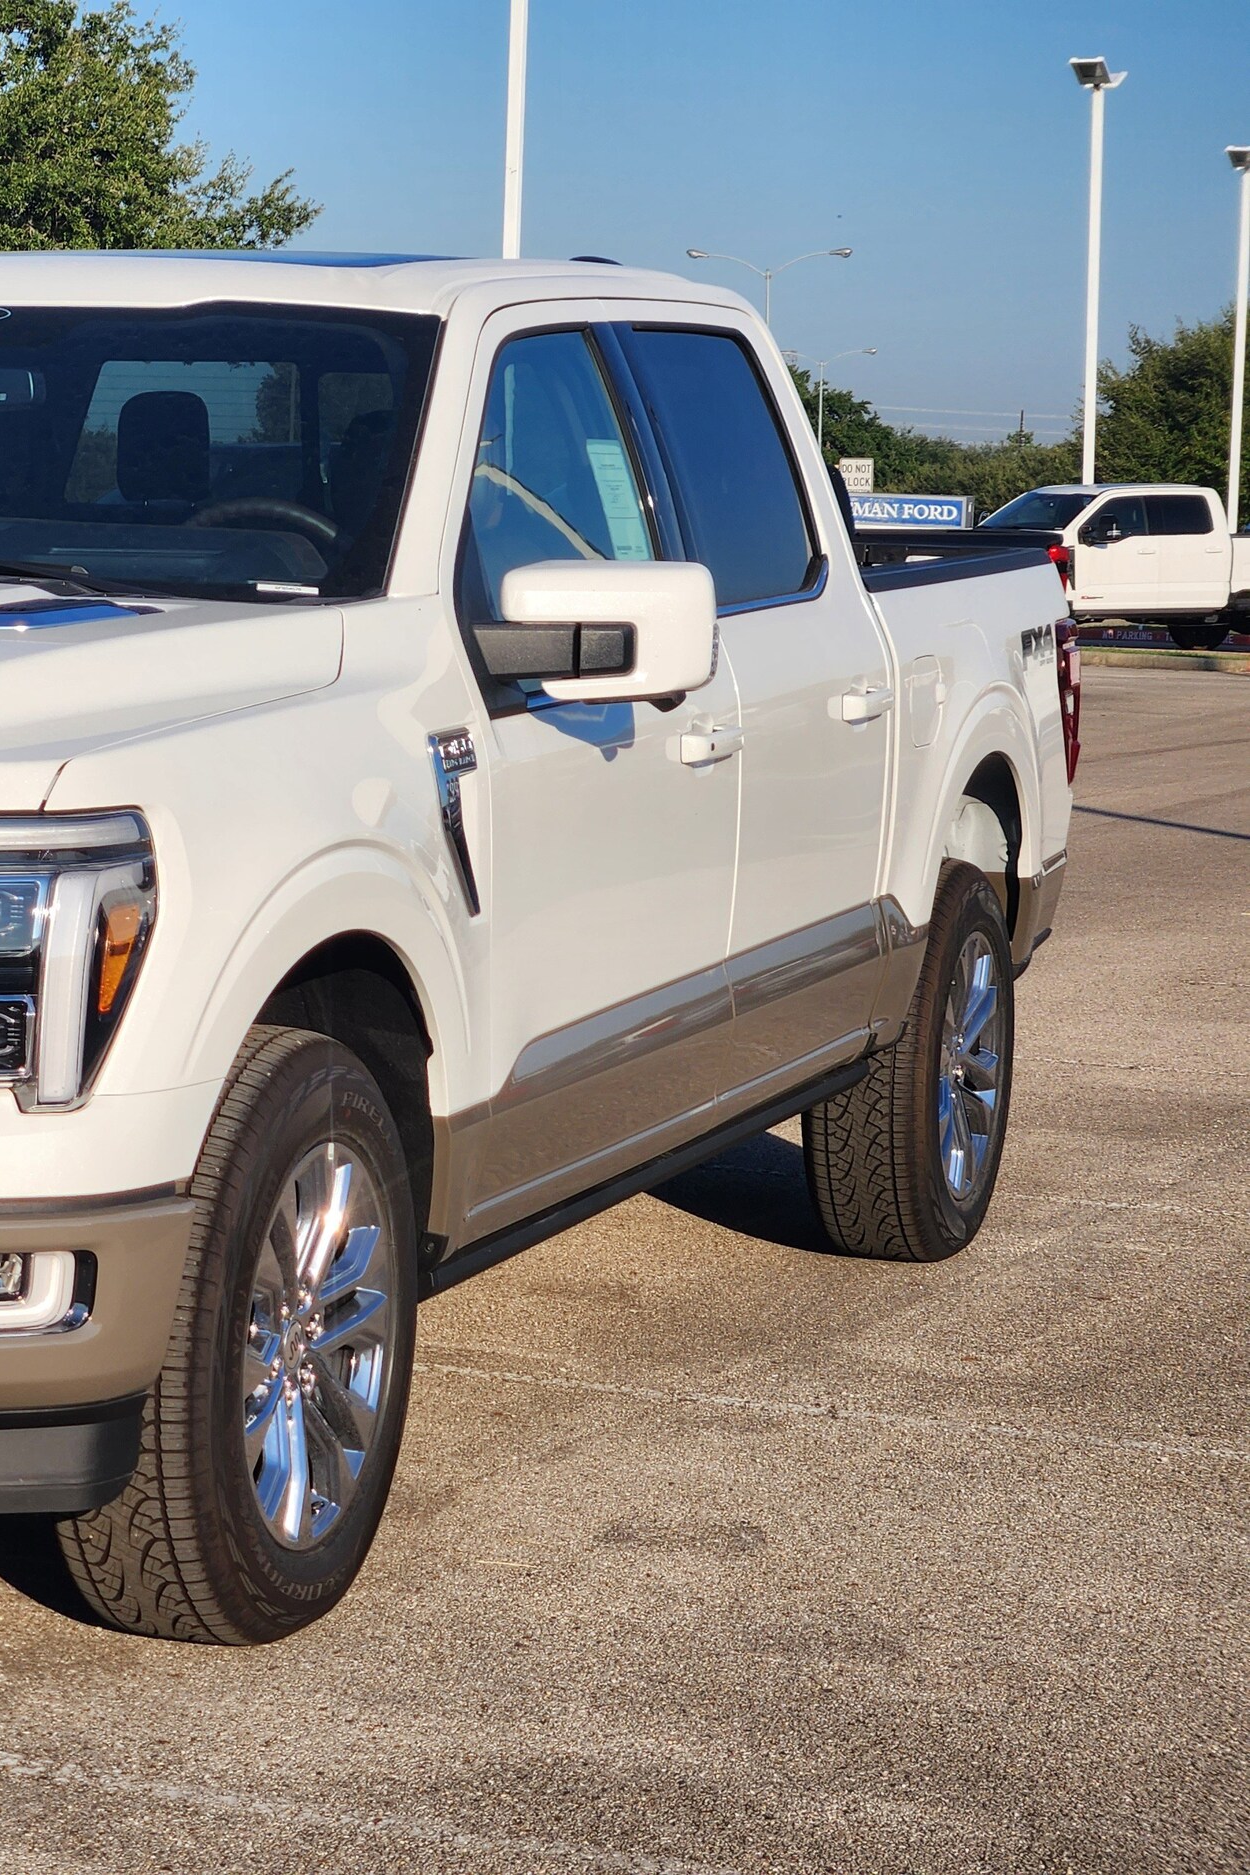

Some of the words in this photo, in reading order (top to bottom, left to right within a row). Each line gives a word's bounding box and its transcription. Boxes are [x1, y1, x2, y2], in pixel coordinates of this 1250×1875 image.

[842, 464, 853, 473] DO
[855, 464, 871, 473] NOT
[850, 502, 899, 519] MAN
[902, 503, 958, 521] FORD
[1116, 630, 1153, 641] PARKING
[1021, 624, 1054, 671] FX4
